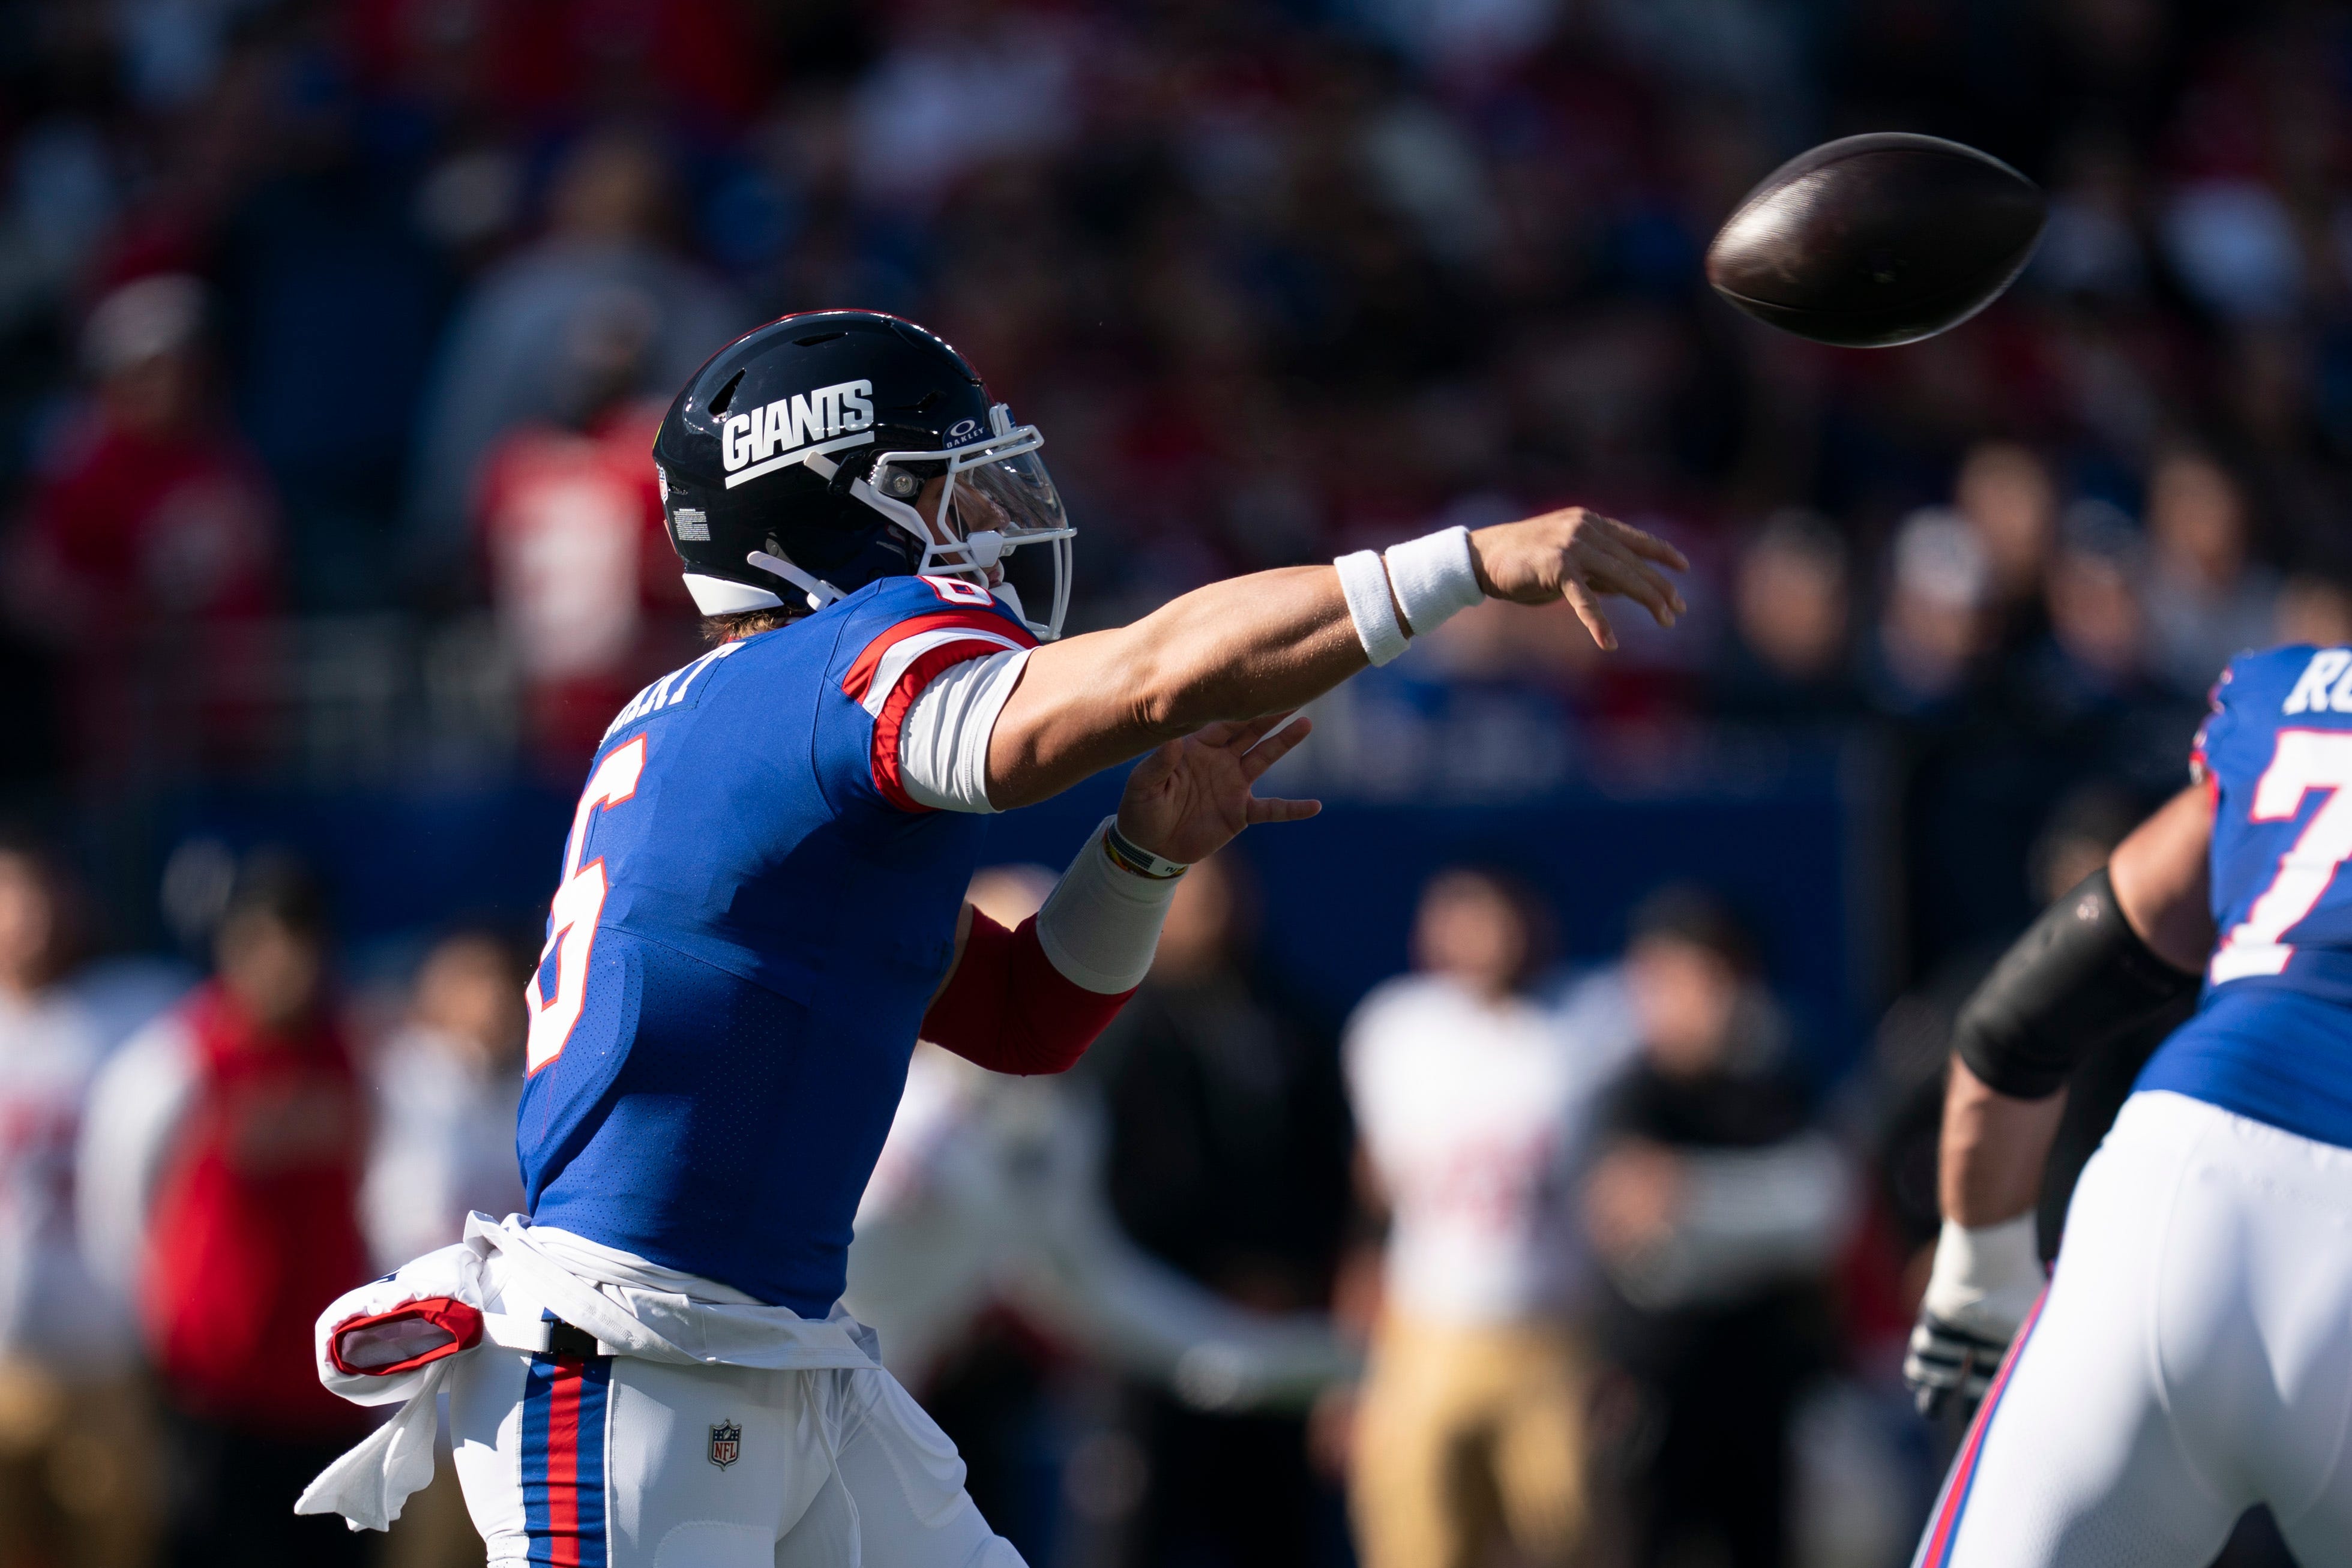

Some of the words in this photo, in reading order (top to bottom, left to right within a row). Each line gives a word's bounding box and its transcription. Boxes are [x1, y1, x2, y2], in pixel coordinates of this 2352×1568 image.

[723, 379, 874, 472] GIANTS
[946, 428, 984, 448] OAKLEY
[714, 1442, 736, 1461] NFL
